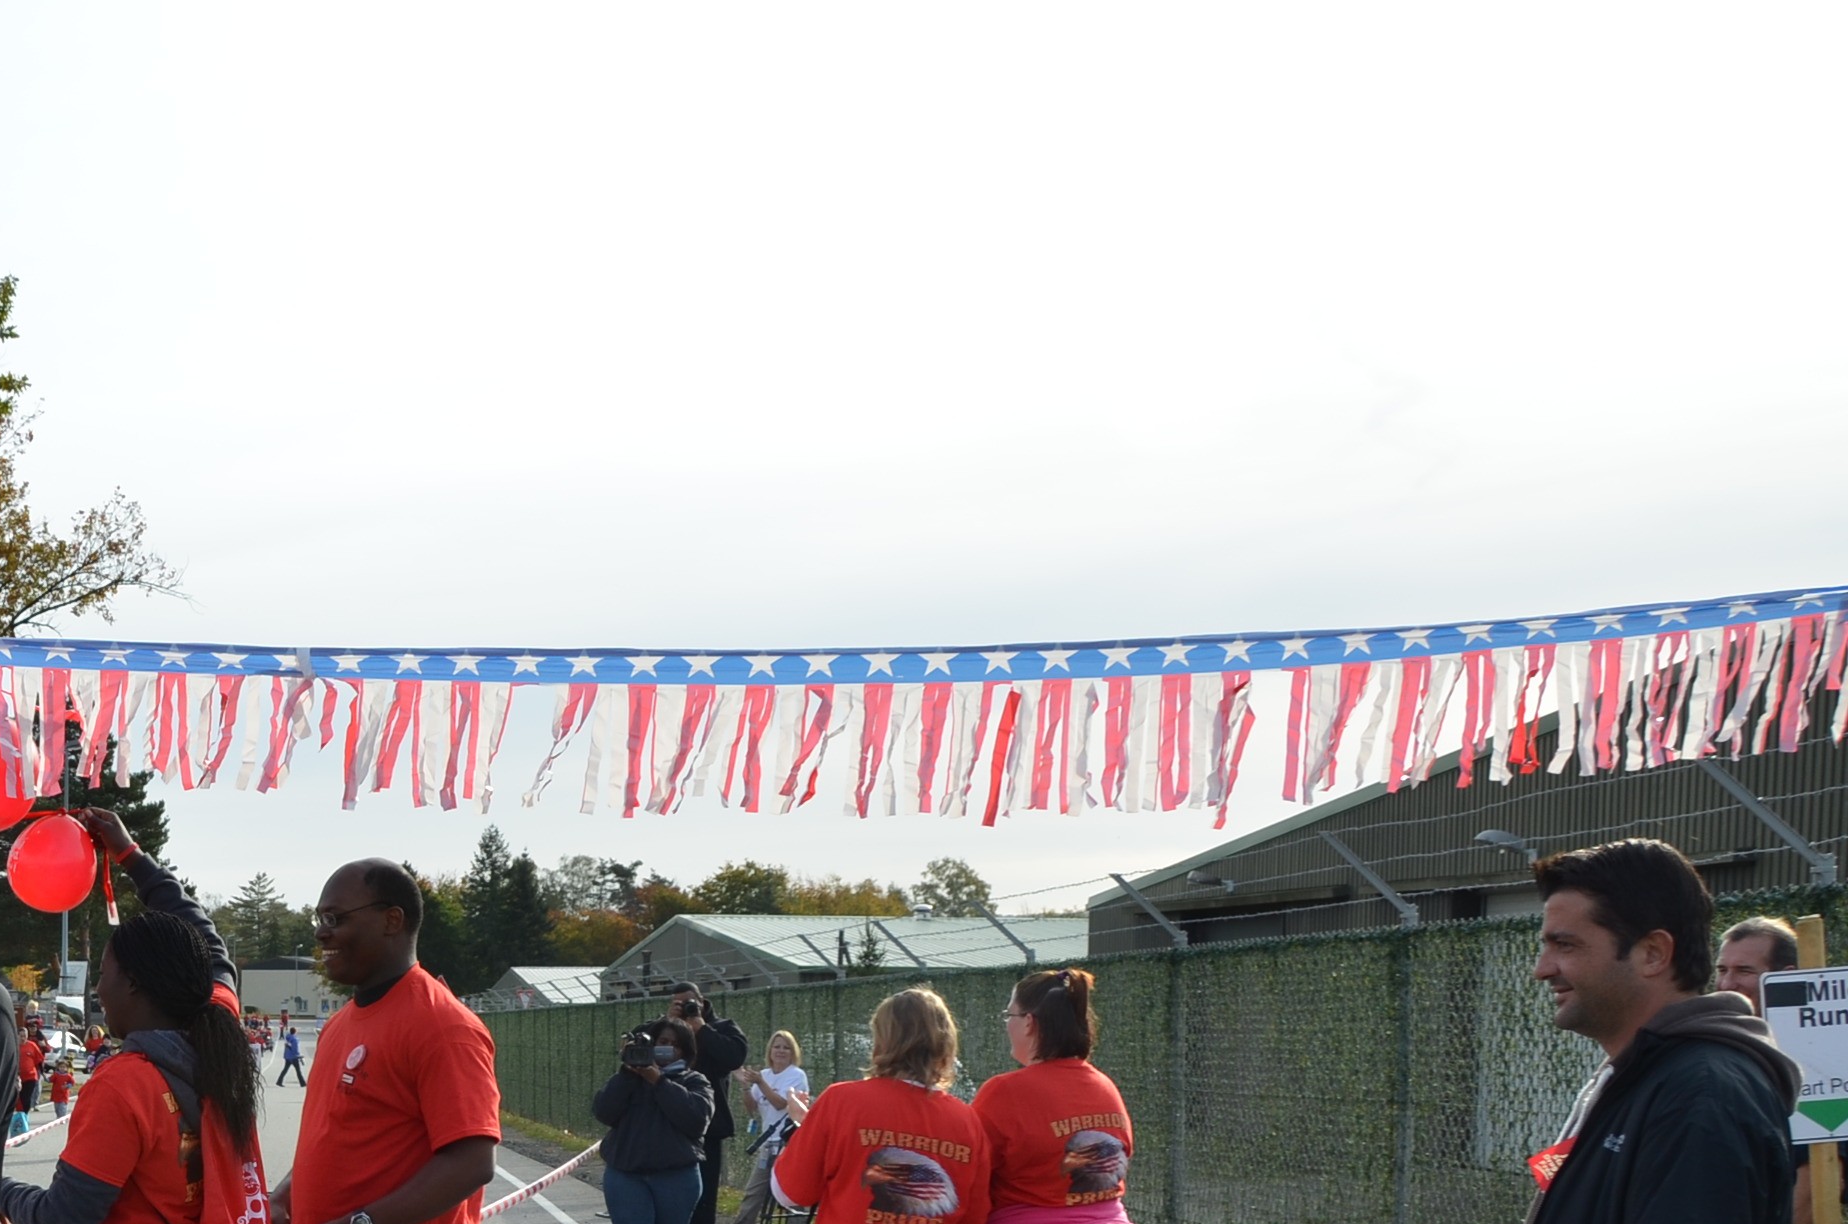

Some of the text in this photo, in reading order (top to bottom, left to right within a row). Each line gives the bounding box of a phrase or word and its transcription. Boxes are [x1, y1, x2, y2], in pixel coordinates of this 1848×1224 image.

[1808, 979, 1848, 1002] Mil
[1800, 1082, 1825, 1096] art
[858, 1128, 971, 1163] WARRIOR
